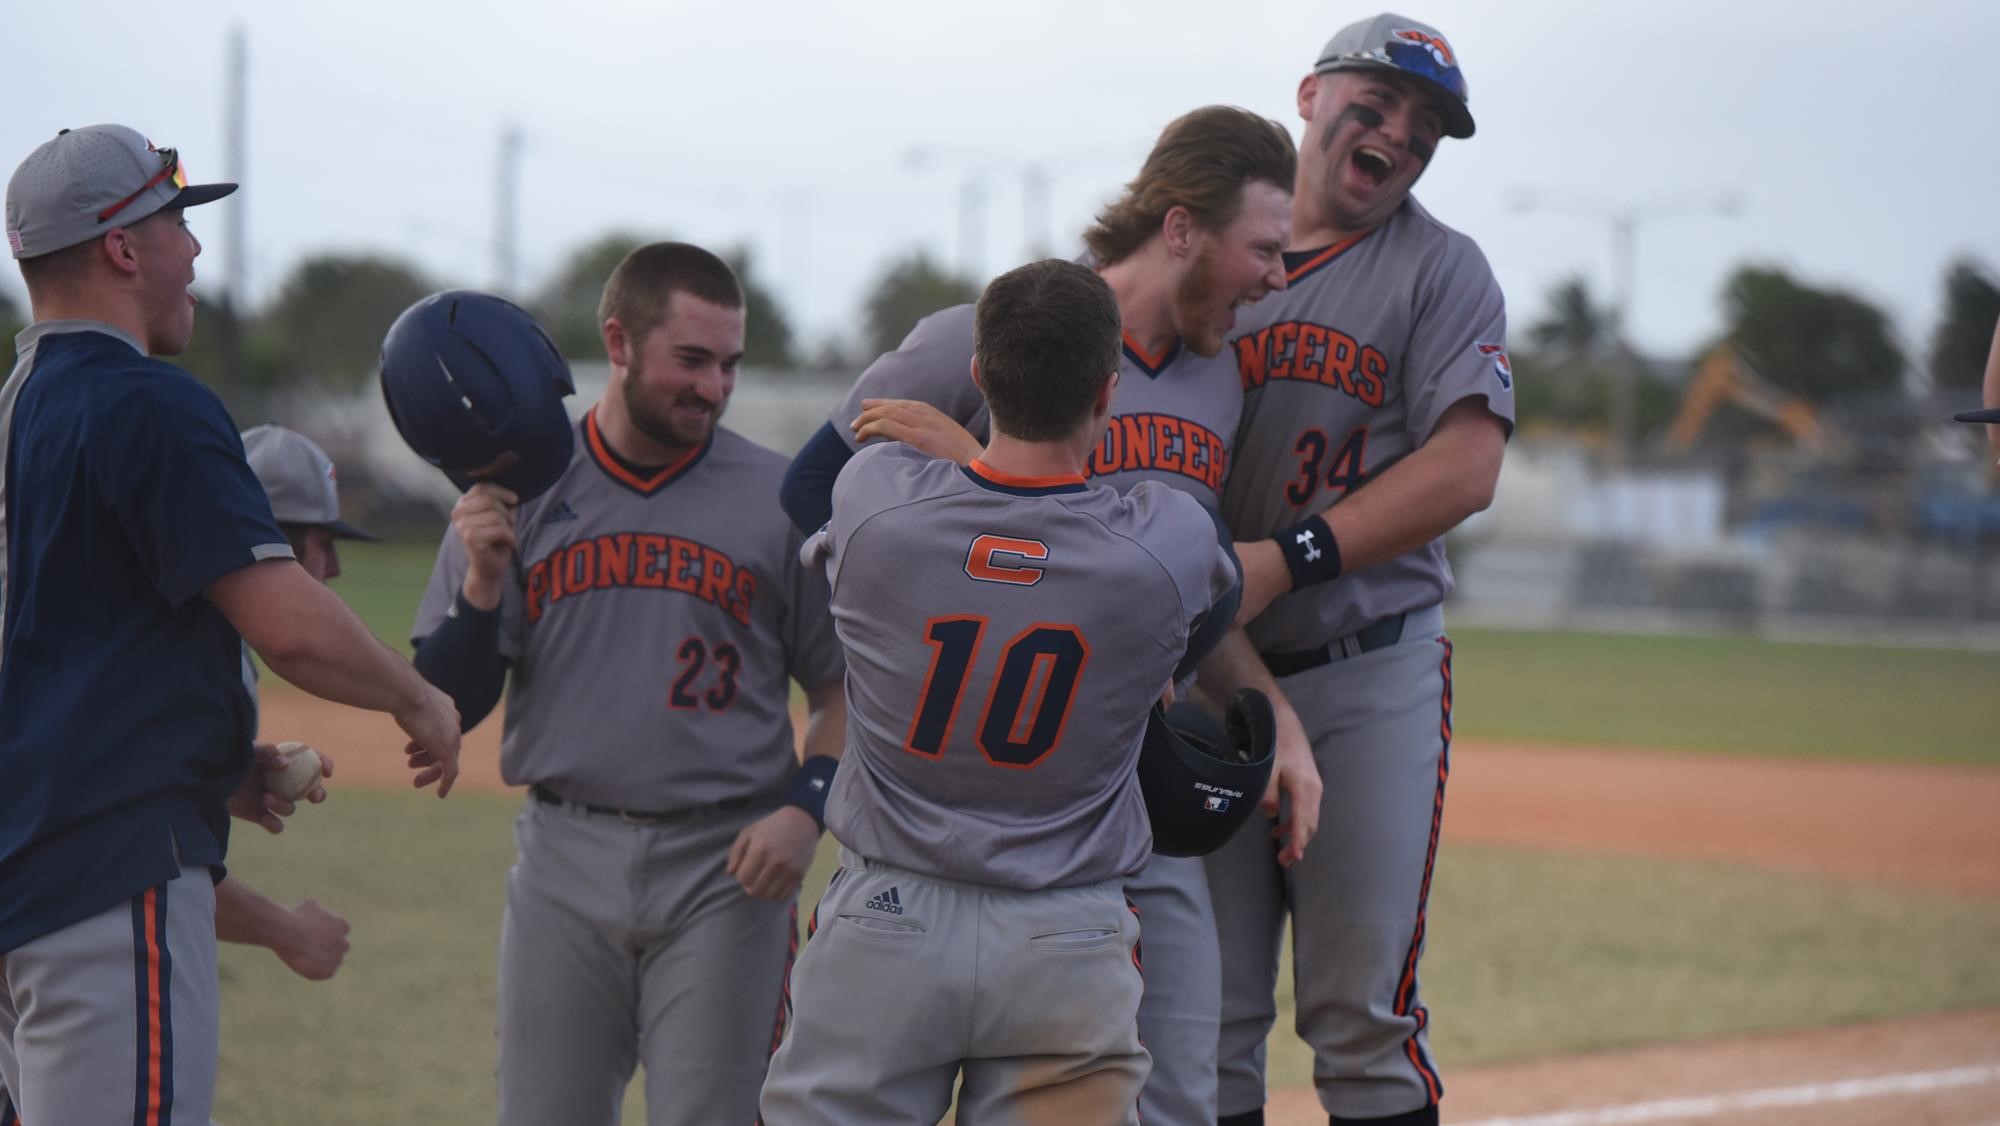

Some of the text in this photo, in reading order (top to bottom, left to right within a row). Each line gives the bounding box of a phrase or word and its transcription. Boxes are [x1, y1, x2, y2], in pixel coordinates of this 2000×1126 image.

[1229, 320, 1389, 408] NEERS
[1082, 411, 1229, 496] ONEER
[1284, 425, 1371, 510] 34
[526, 530, 757, 629] PIONEERS
[962, 532, 1050, 587] C
[667, 632, 742, 715] 23
[904, 612, 1093, 772] 10
[865, 900, 904, 916] adidas
